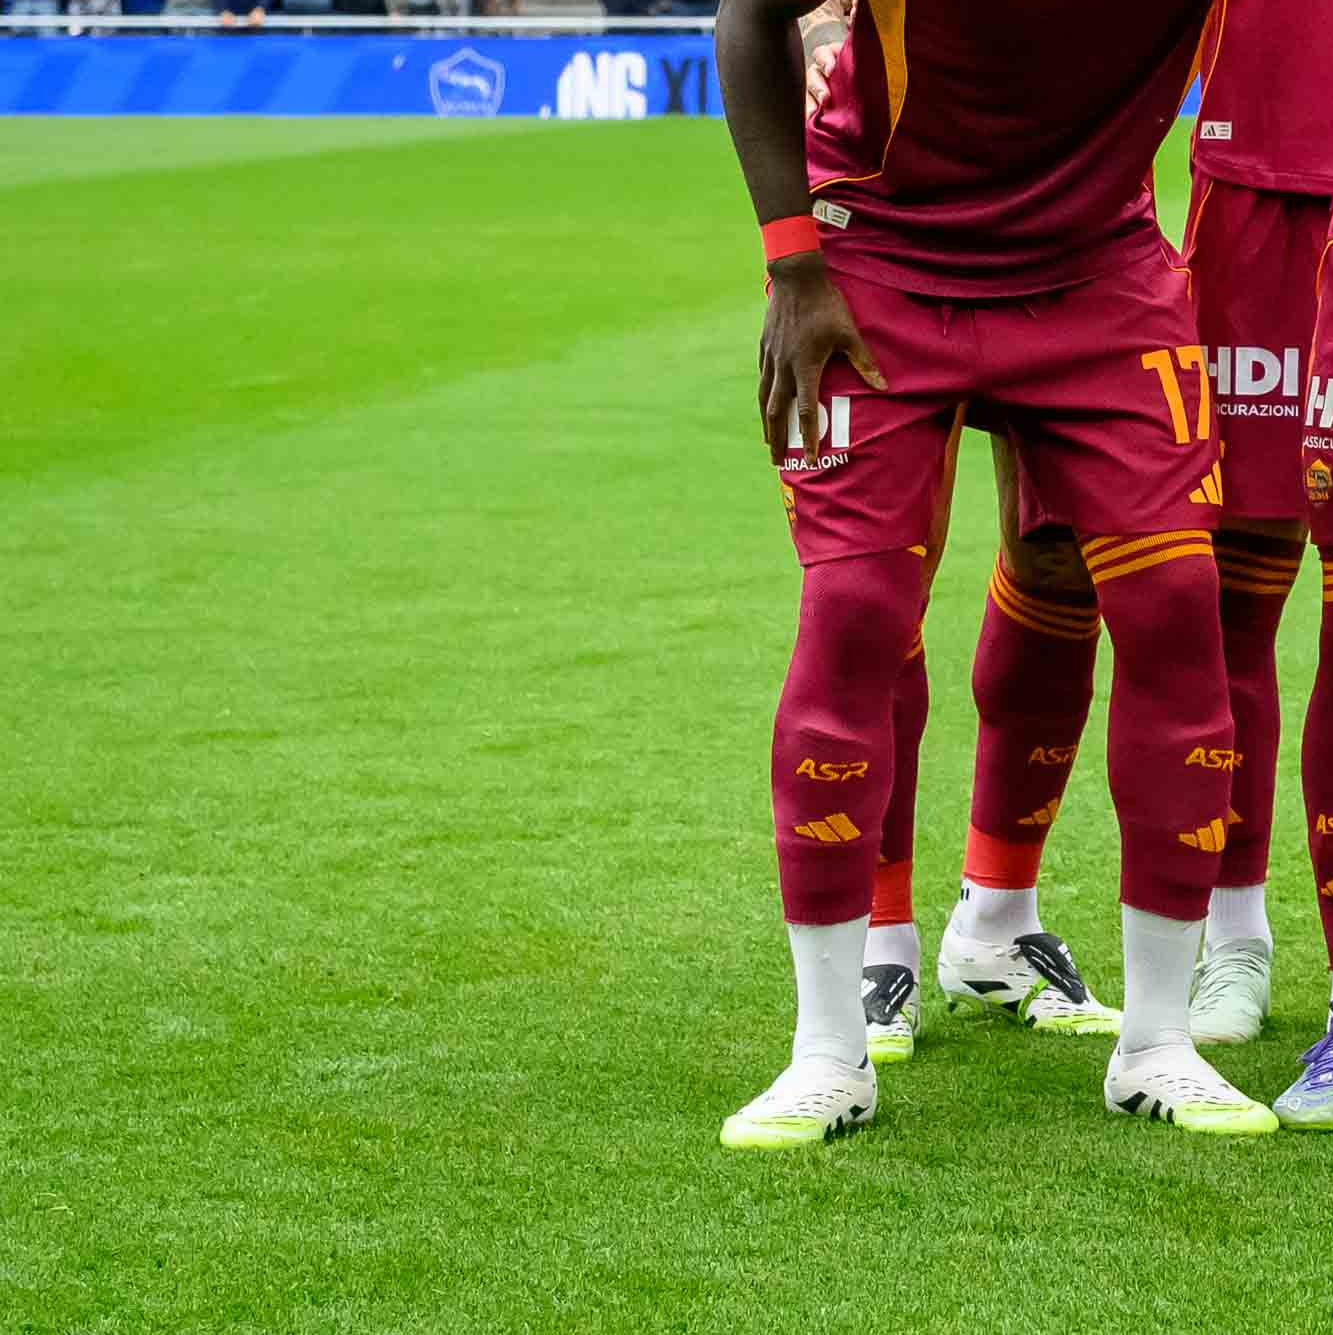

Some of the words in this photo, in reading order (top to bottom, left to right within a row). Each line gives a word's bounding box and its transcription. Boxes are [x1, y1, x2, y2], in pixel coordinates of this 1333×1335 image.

[661, 56, 707, 114] XI
[787, 395, 851, 449] DI
[1141, 344, 1211, 445] 17
